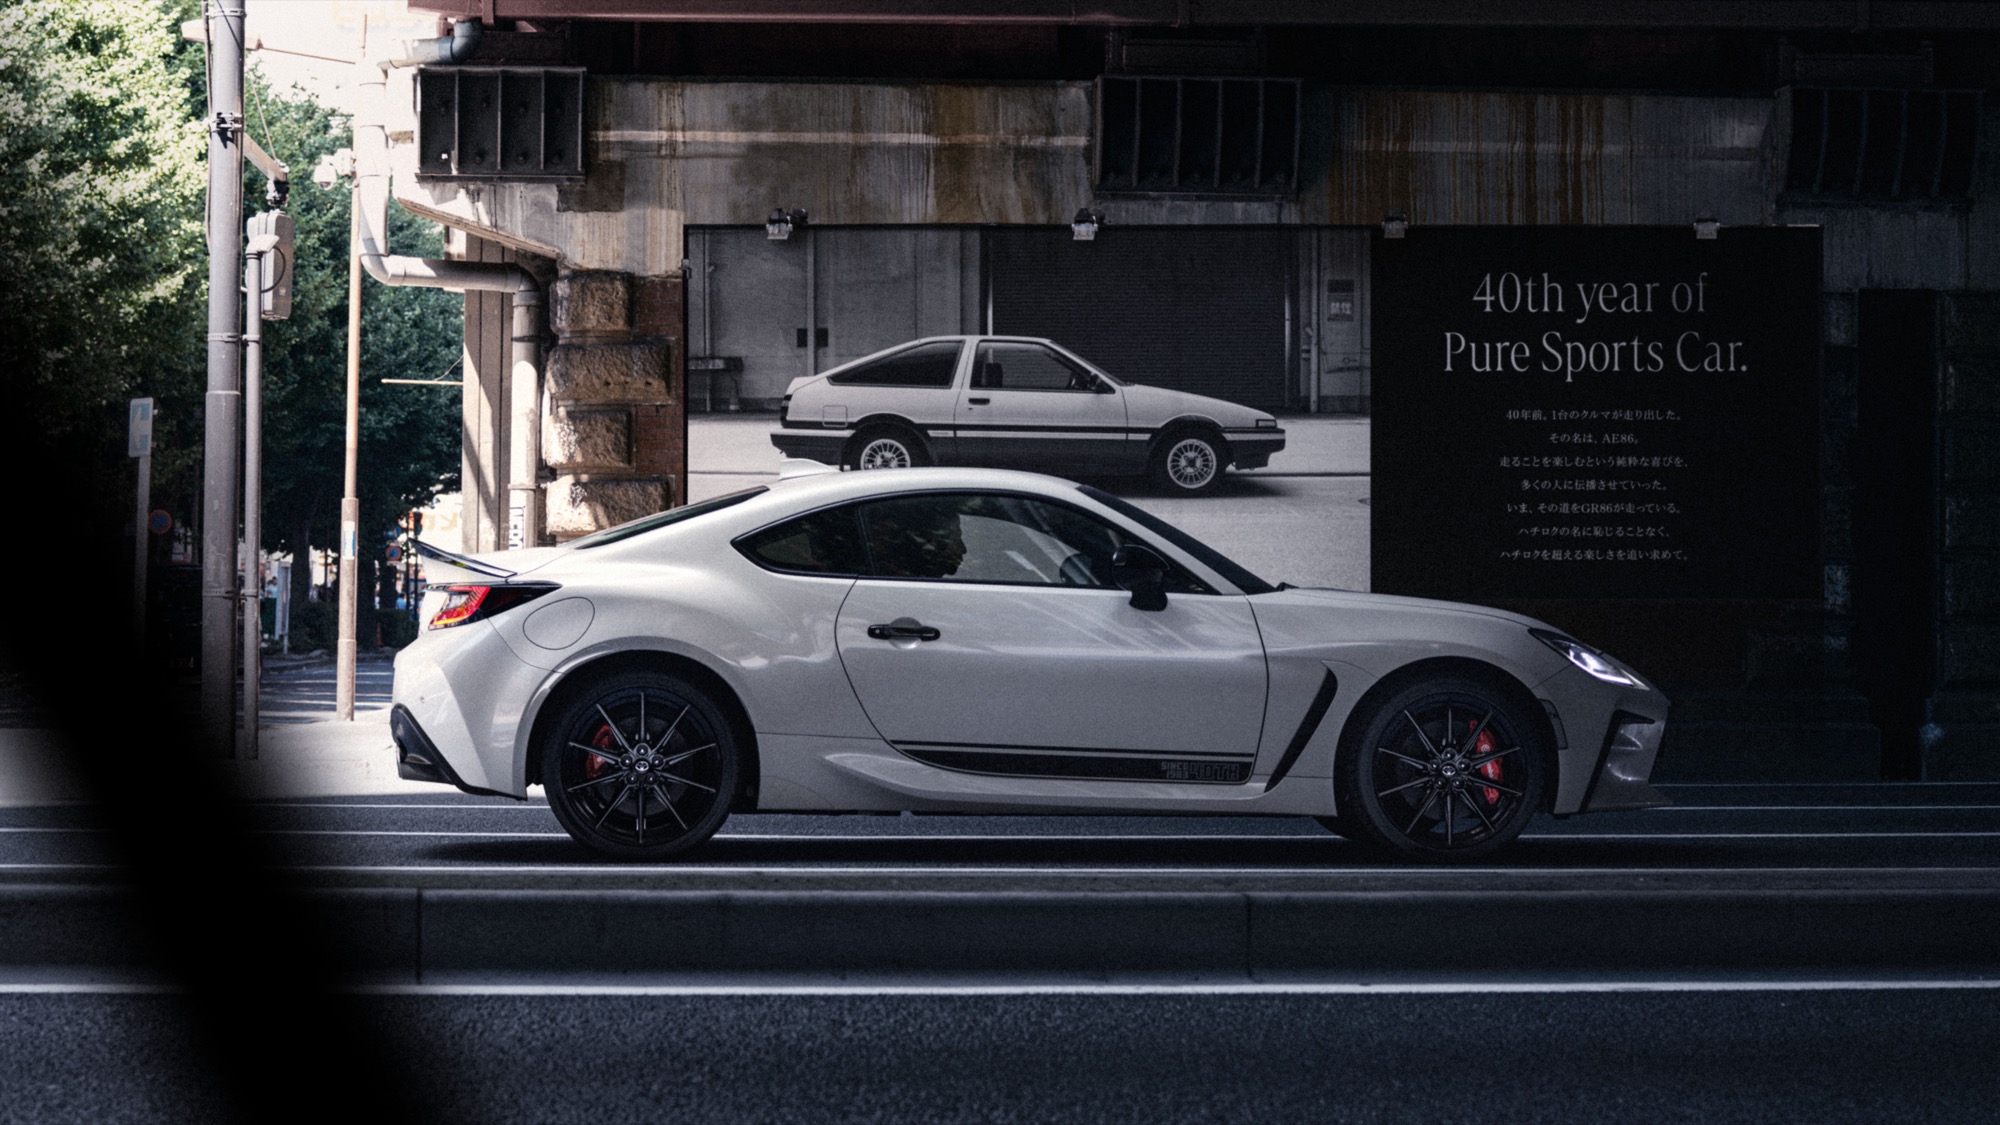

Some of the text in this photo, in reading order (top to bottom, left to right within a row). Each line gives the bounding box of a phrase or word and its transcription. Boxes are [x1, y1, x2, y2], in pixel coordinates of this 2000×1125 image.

[1472, 271, 1708, 324] 40th year of
[1444, 331, 1748, 383] Pure Sports Car.
